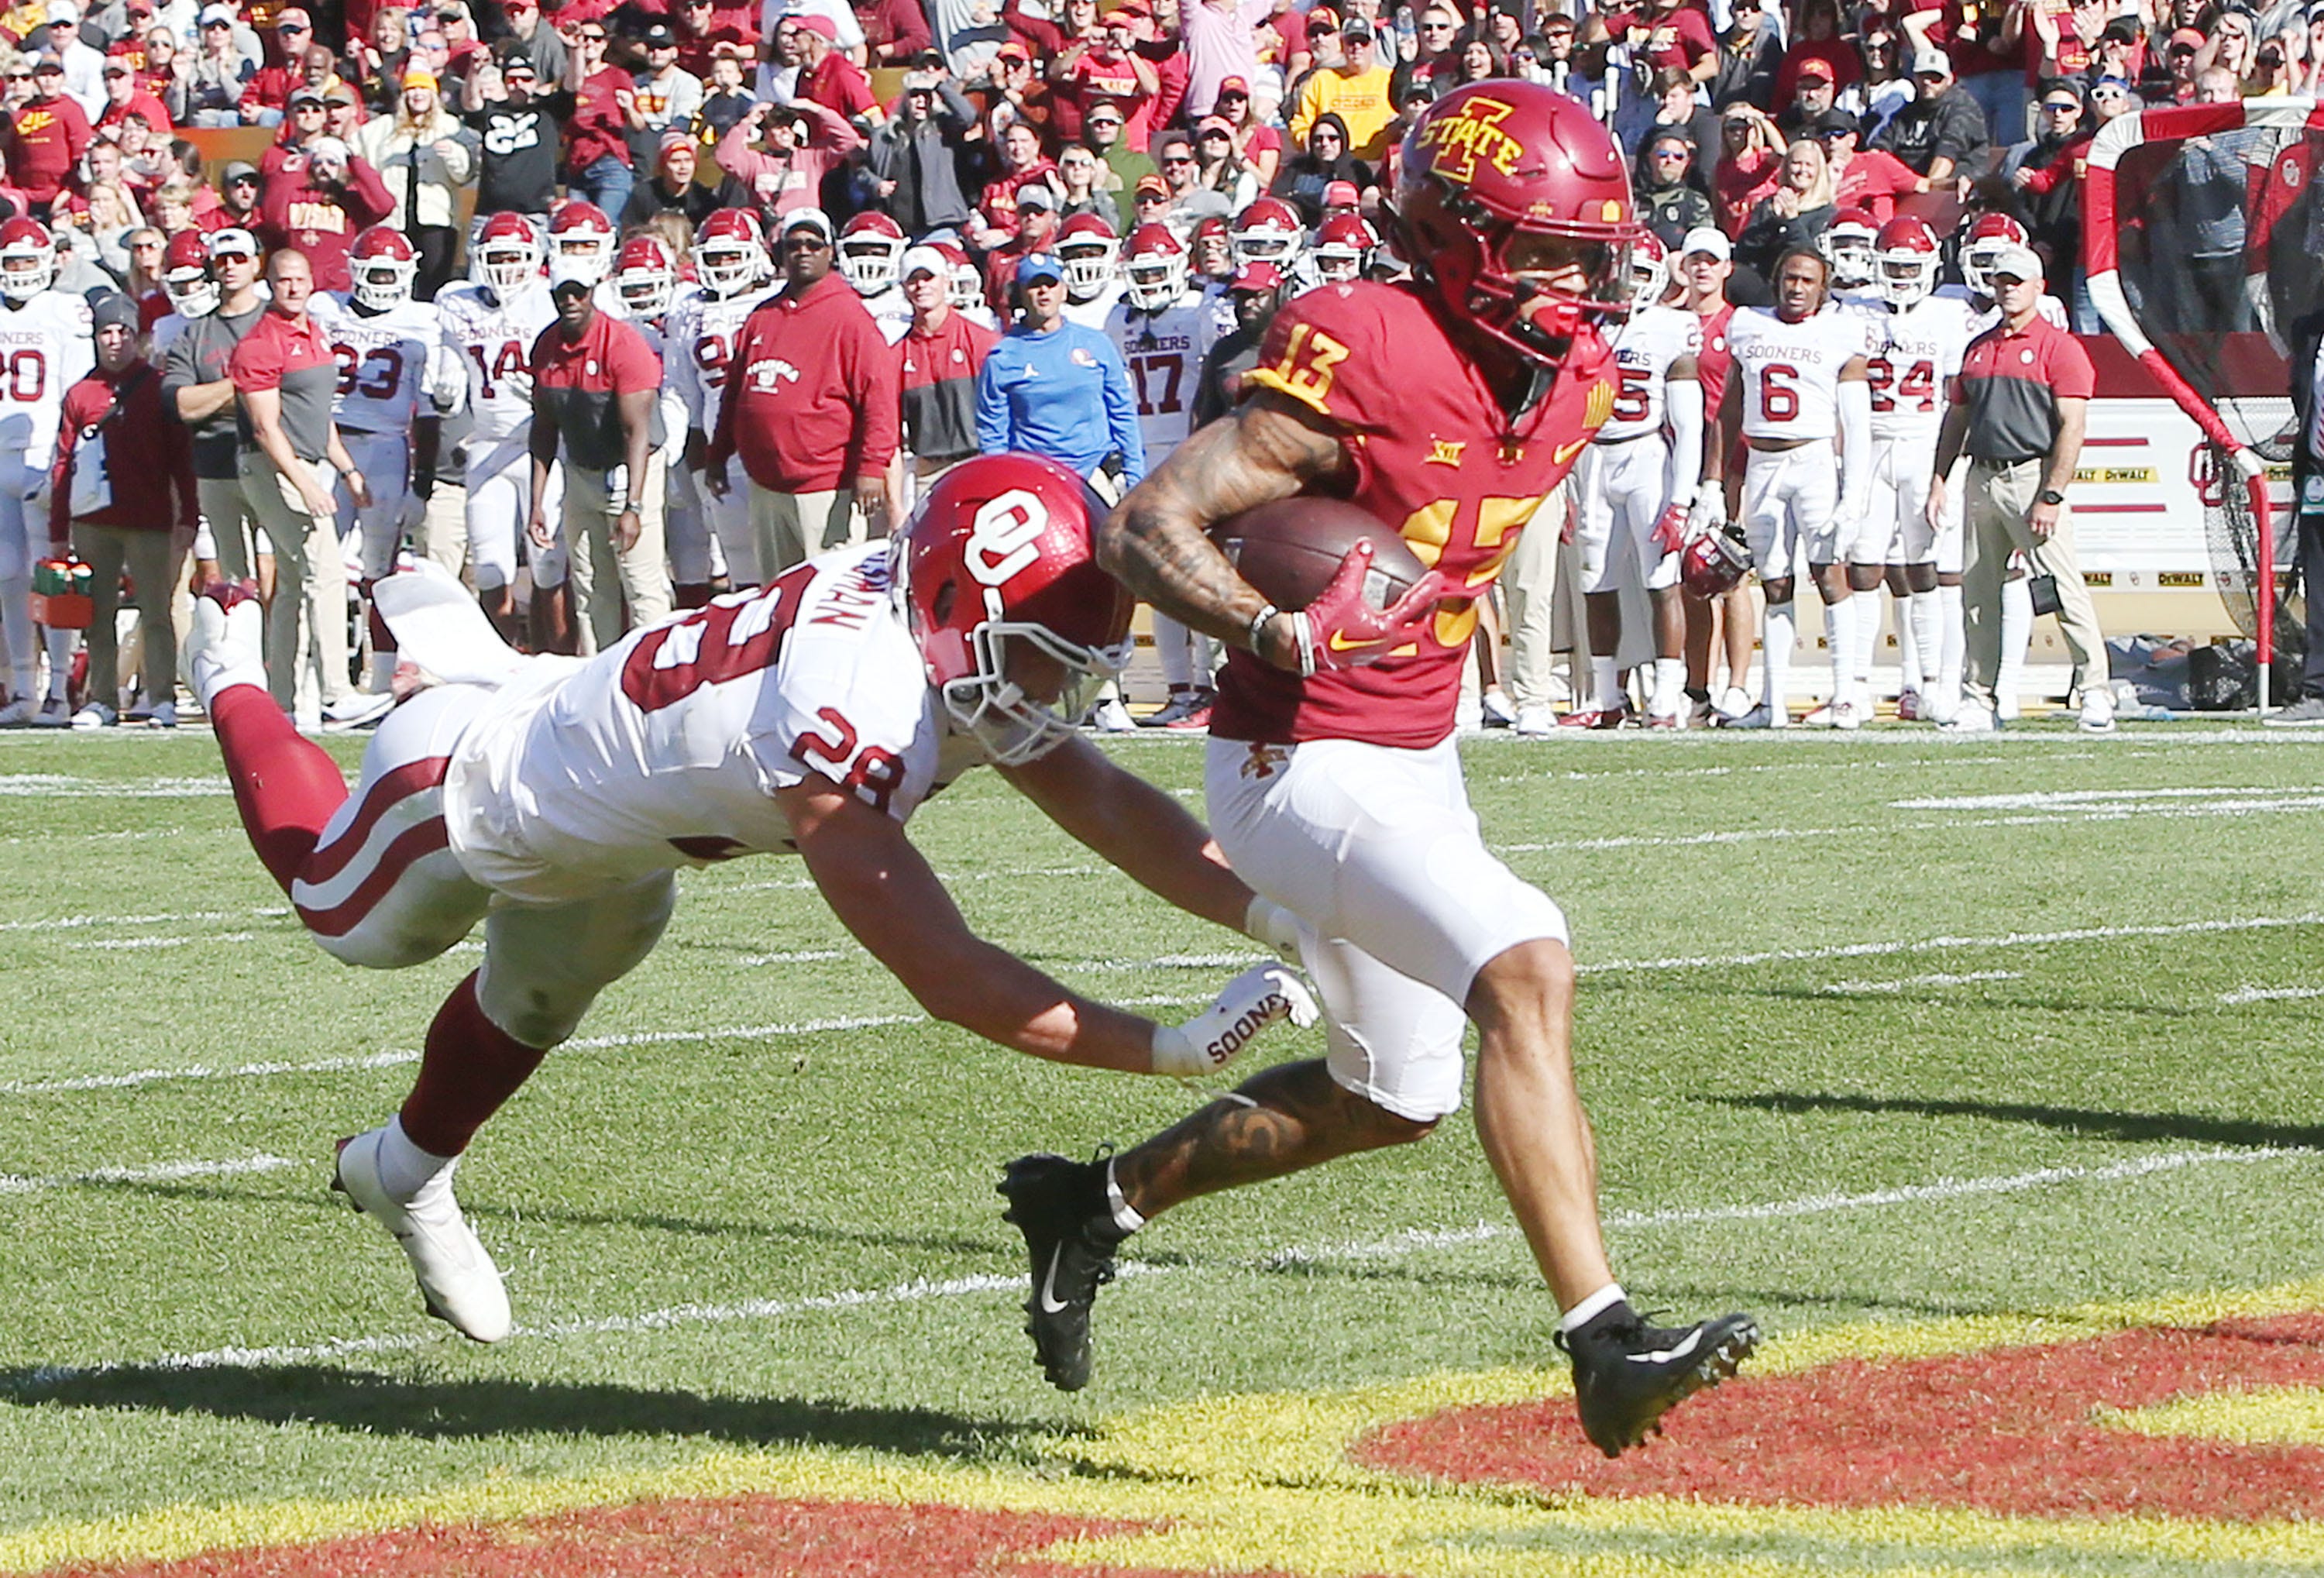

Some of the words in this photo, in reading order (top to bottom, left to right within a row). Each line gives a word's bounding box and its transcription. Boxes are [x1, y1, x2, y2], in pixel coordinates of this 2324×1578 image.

[1415, 116, 1525, 177] STATE
[0, 349, 46, 402] 0
[467, 340, 533, 399] 14
[1129, 353, 1183, 416] 17
[1276, 322, 1351, 401] 13
[1745, 345, 1822, 365] SOONERS
[1760, 363, 1800, 422] 6
[1867, 358, 1934, 412] 24
[788, 706, 907, 814] 28
